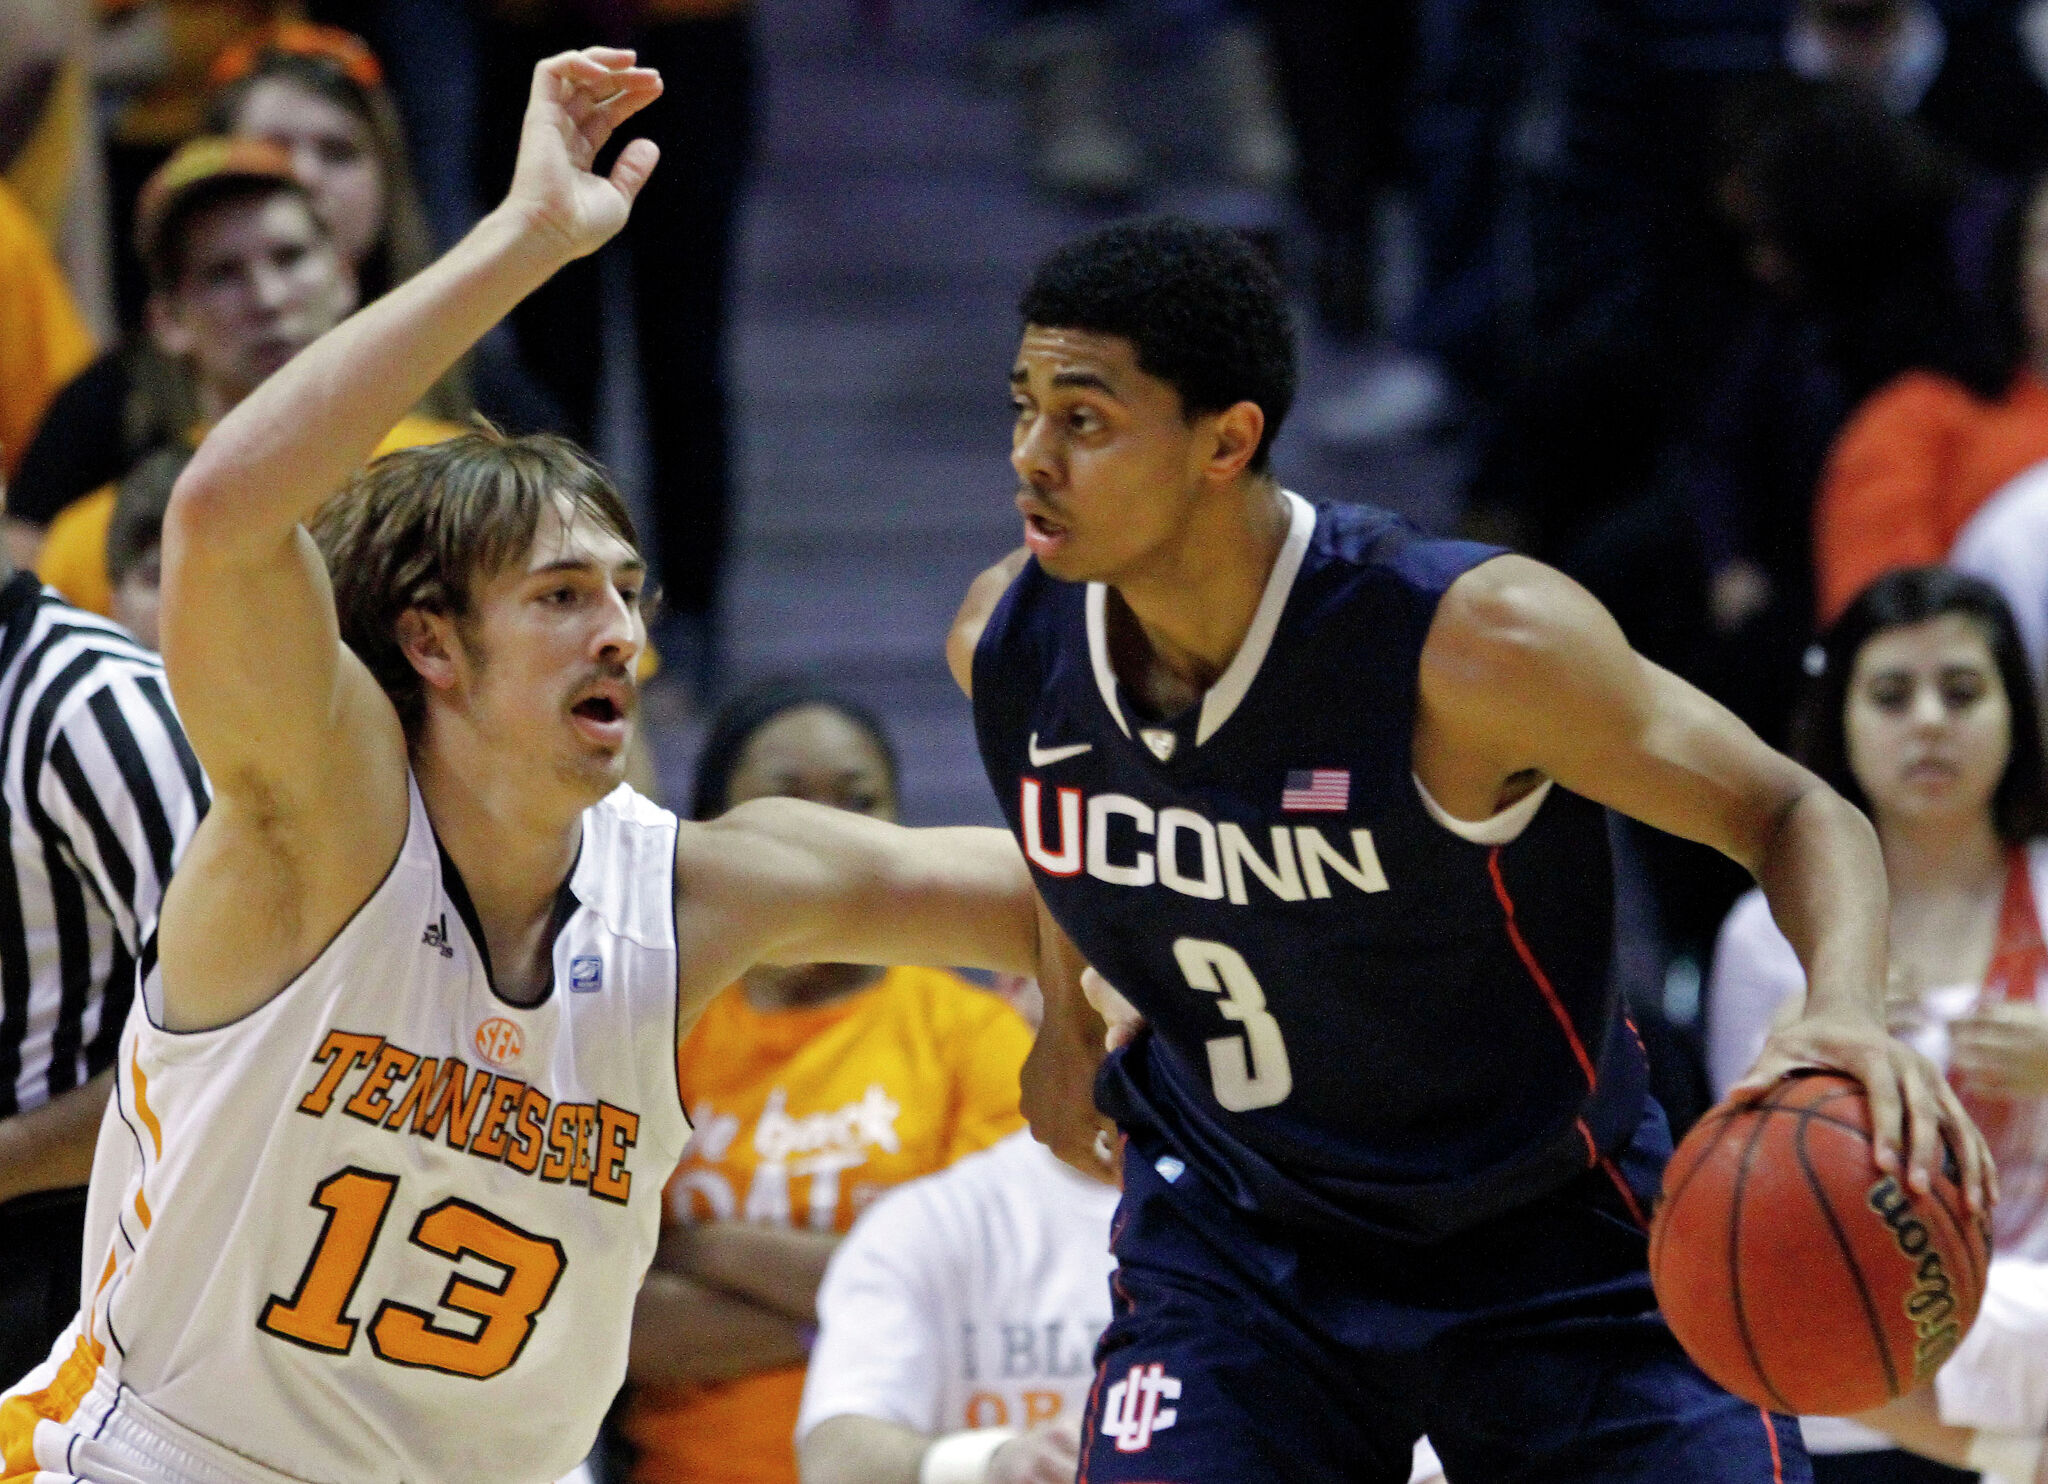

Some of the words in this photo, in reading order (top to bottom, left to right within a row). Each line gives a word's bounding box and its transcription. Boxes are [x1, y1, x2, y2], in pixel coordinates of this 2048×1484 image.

[1020, 778, 1390, 905] UCONN
[1172, 937, 1294, 1113] 3
[297, 1029, 640, 1206] TENNESSEE
[256, 1165, 568, 1382] 13
[1000, 1319, 1113, 1379] BL
